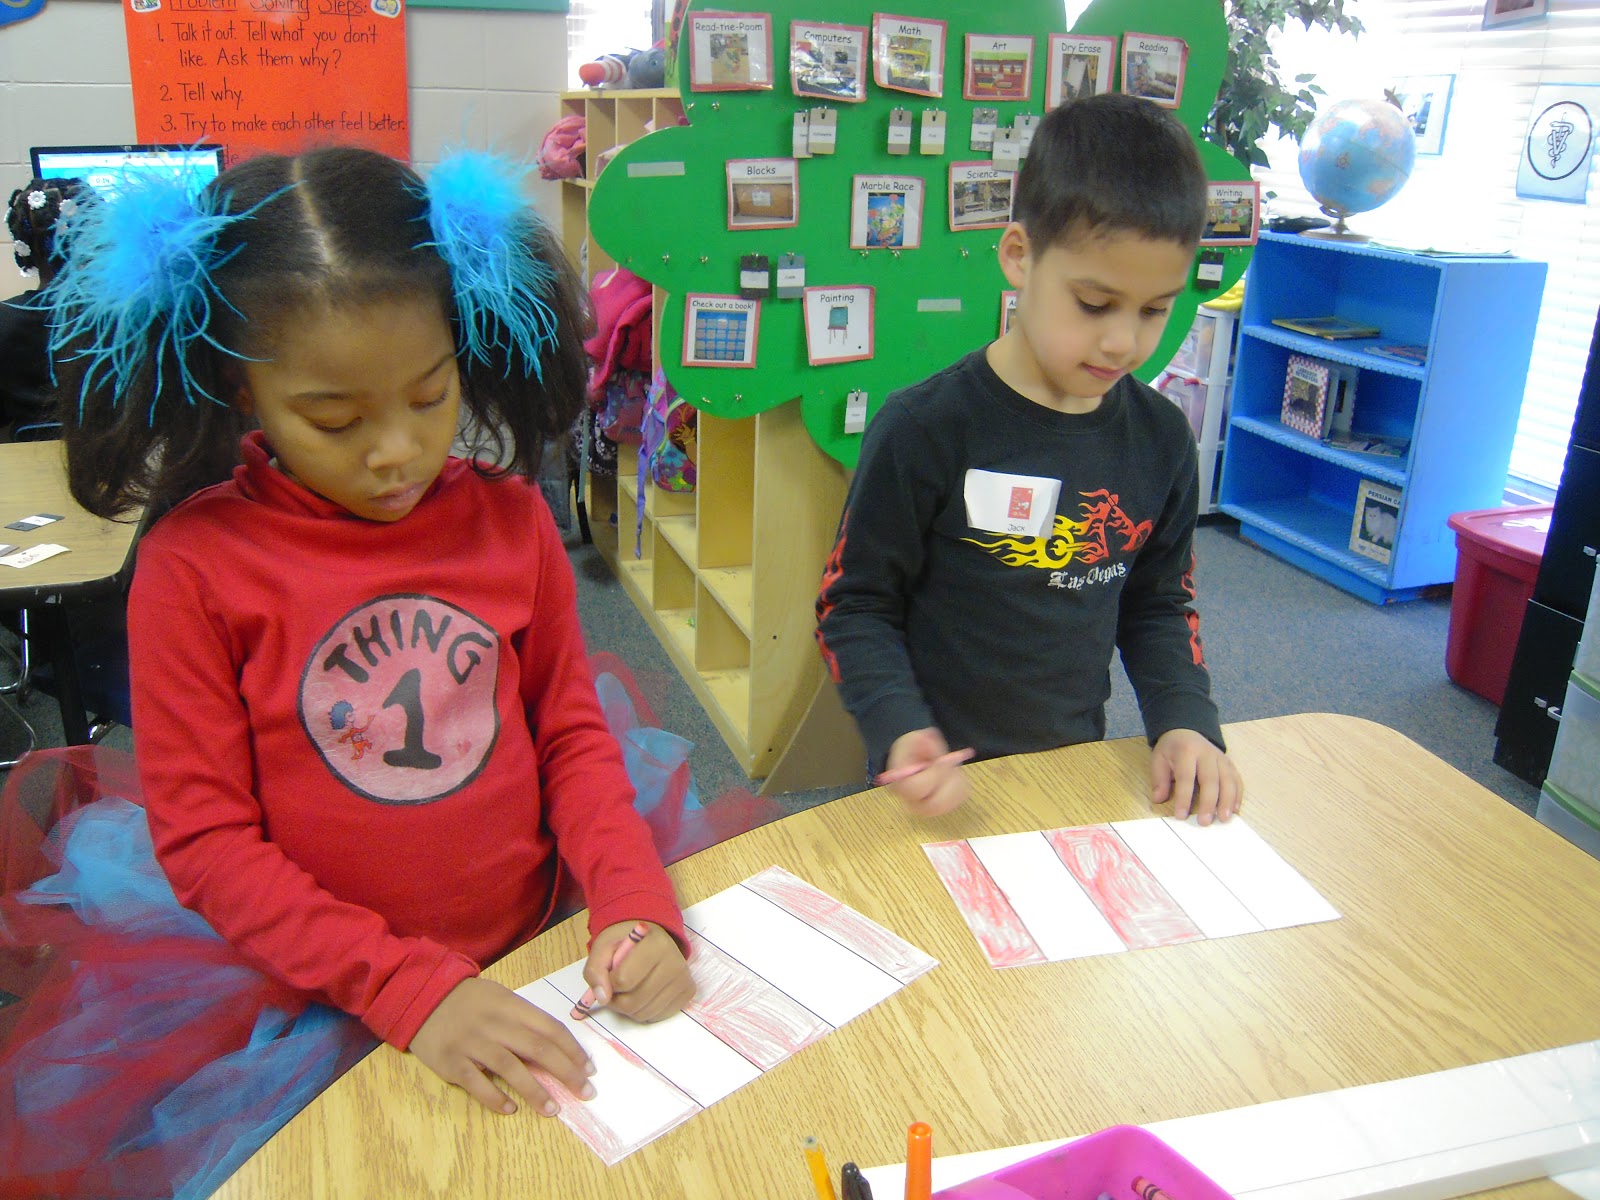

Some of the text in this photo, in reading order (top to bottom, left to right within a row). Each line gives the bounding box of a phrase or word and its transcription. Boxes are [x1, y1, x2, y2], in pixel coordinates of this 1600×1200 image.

[157, 18, 379, 51] 1. Talk it out. Tell what you don't
[899, 24, 922, 36] Math
[803, 30, 852, 44] Computers
[992, 41, 1007, 51] Art
[1061, 42, 1102, 55] Dry Erase
[1139, 41, 1170, 55] Reading
[216, 47, 249, 67] Ask
[256, 47, 294, 67] them
[160, 76, 244, 111] 2. Tell why.
[160, 110, 406, 138] 3. Try to make each other feel better.
[746, 165, 776, 176] Blocks
[966, 170, 998, 179] Science
[860, 180, 915, 191] Marble Race
[1215, 188, 1243, 198] Writing
[692, 299, 714, 309] Check
[714, 301, 727, 309] out
[735, 302, 754, 311] book!
[819, 293, 855, 305] Painting
[1367, 489, 1393, 503] PERSIAN
[1007, 523, 1026, 532] Jack
[323, 608, 493, 686] THING
[381, 667, 443, 771] 1
